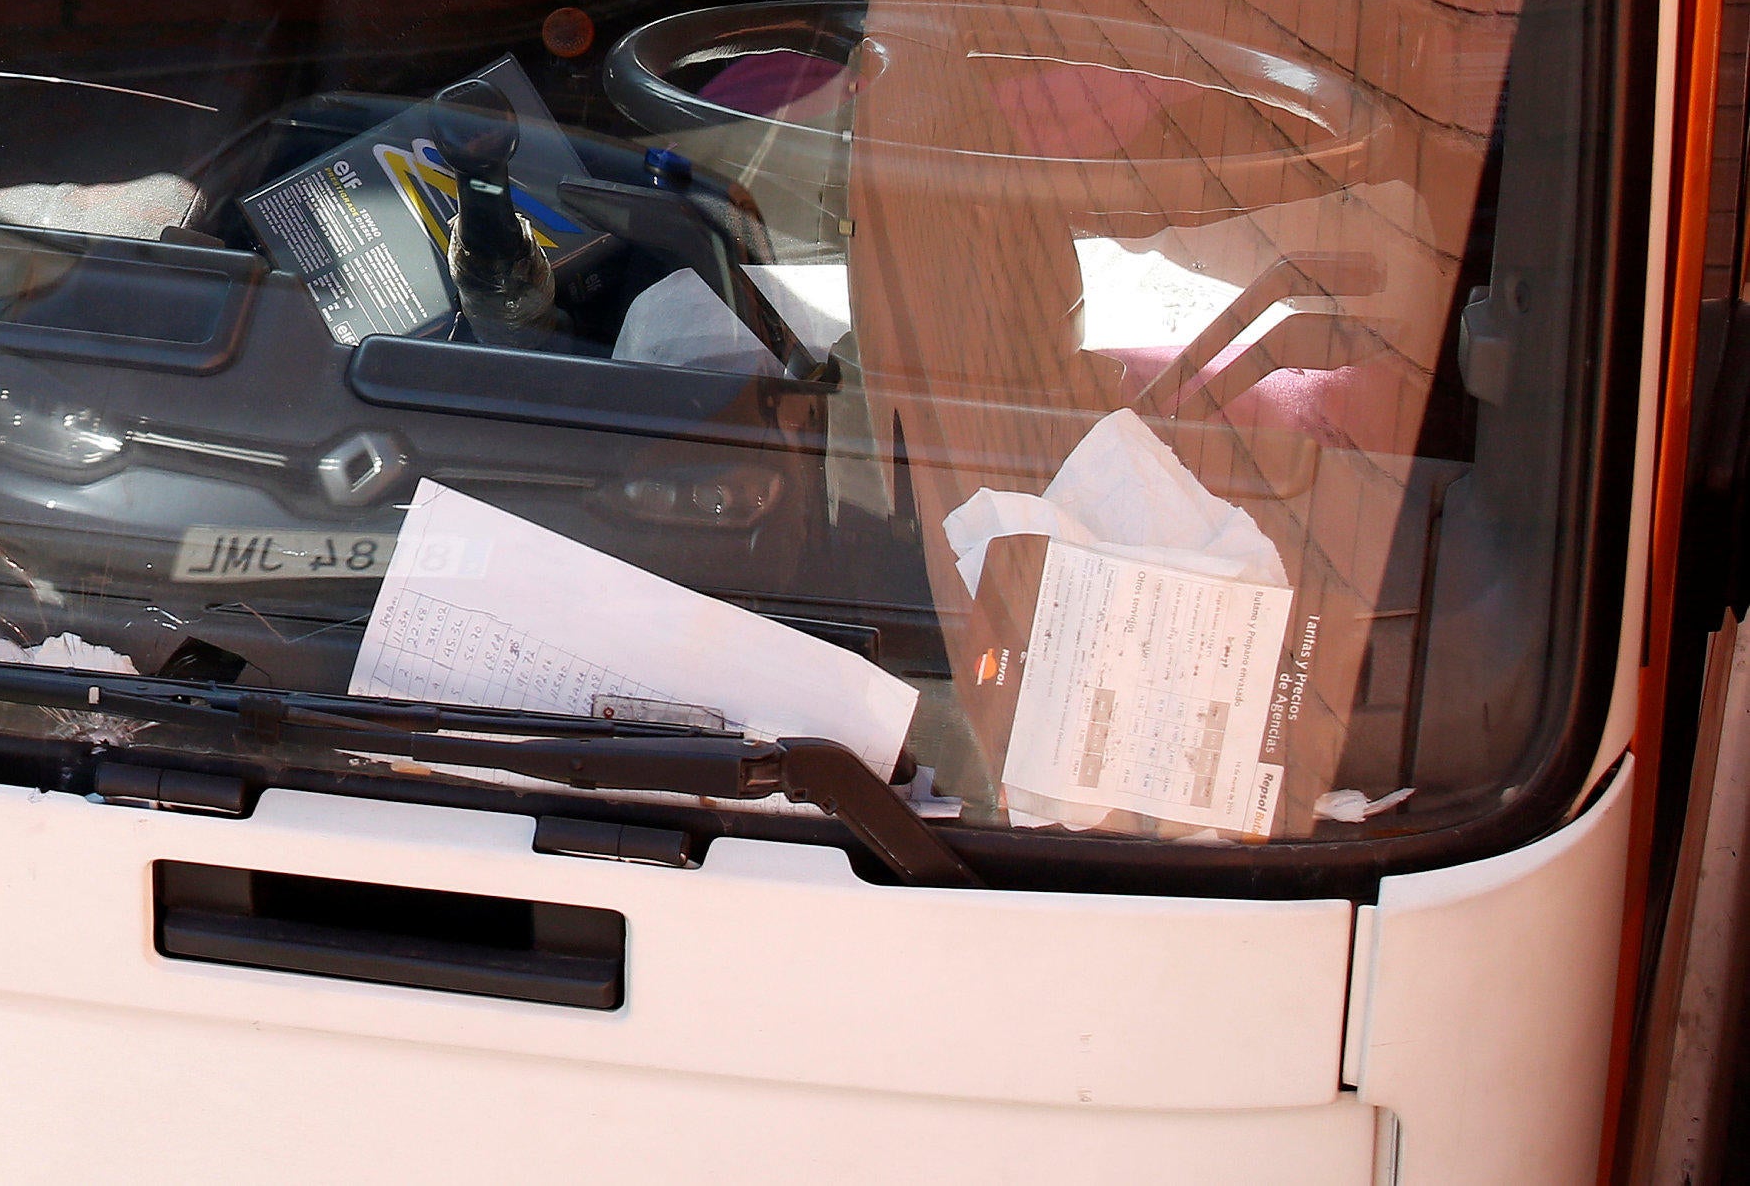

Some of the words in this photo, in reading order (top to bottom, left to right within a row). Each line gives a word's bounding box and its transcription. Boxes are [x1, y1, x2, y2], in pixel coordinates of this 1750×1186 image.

[333, 160, 362, 190] elf
[325, 166, 359, 217] PRESTIGRADE
[355, 216, 373, 243] DIESEL
[360, 208, 381, 238] 15W40
[1133, 570, 1147, 596] Otros
[1124, 597, 1142, 634] servicios
[1248, 590, 1264, 621] Butano
[1238, 629, 1256, 666] Propano
[1298, 613, 1320, 659] Tarifas
[994, 648, 1010, 686] REPSOL
[1276, 672, 1293, 691] de
[1295, 659, 1307, 669] y
[1230, 667, 1249, 708] envasado
[1285, 672, 1308, 721] Precios
[1261, 693, 1288, 755] Agencias
[1253, 772, 1274, 811] Repsol
